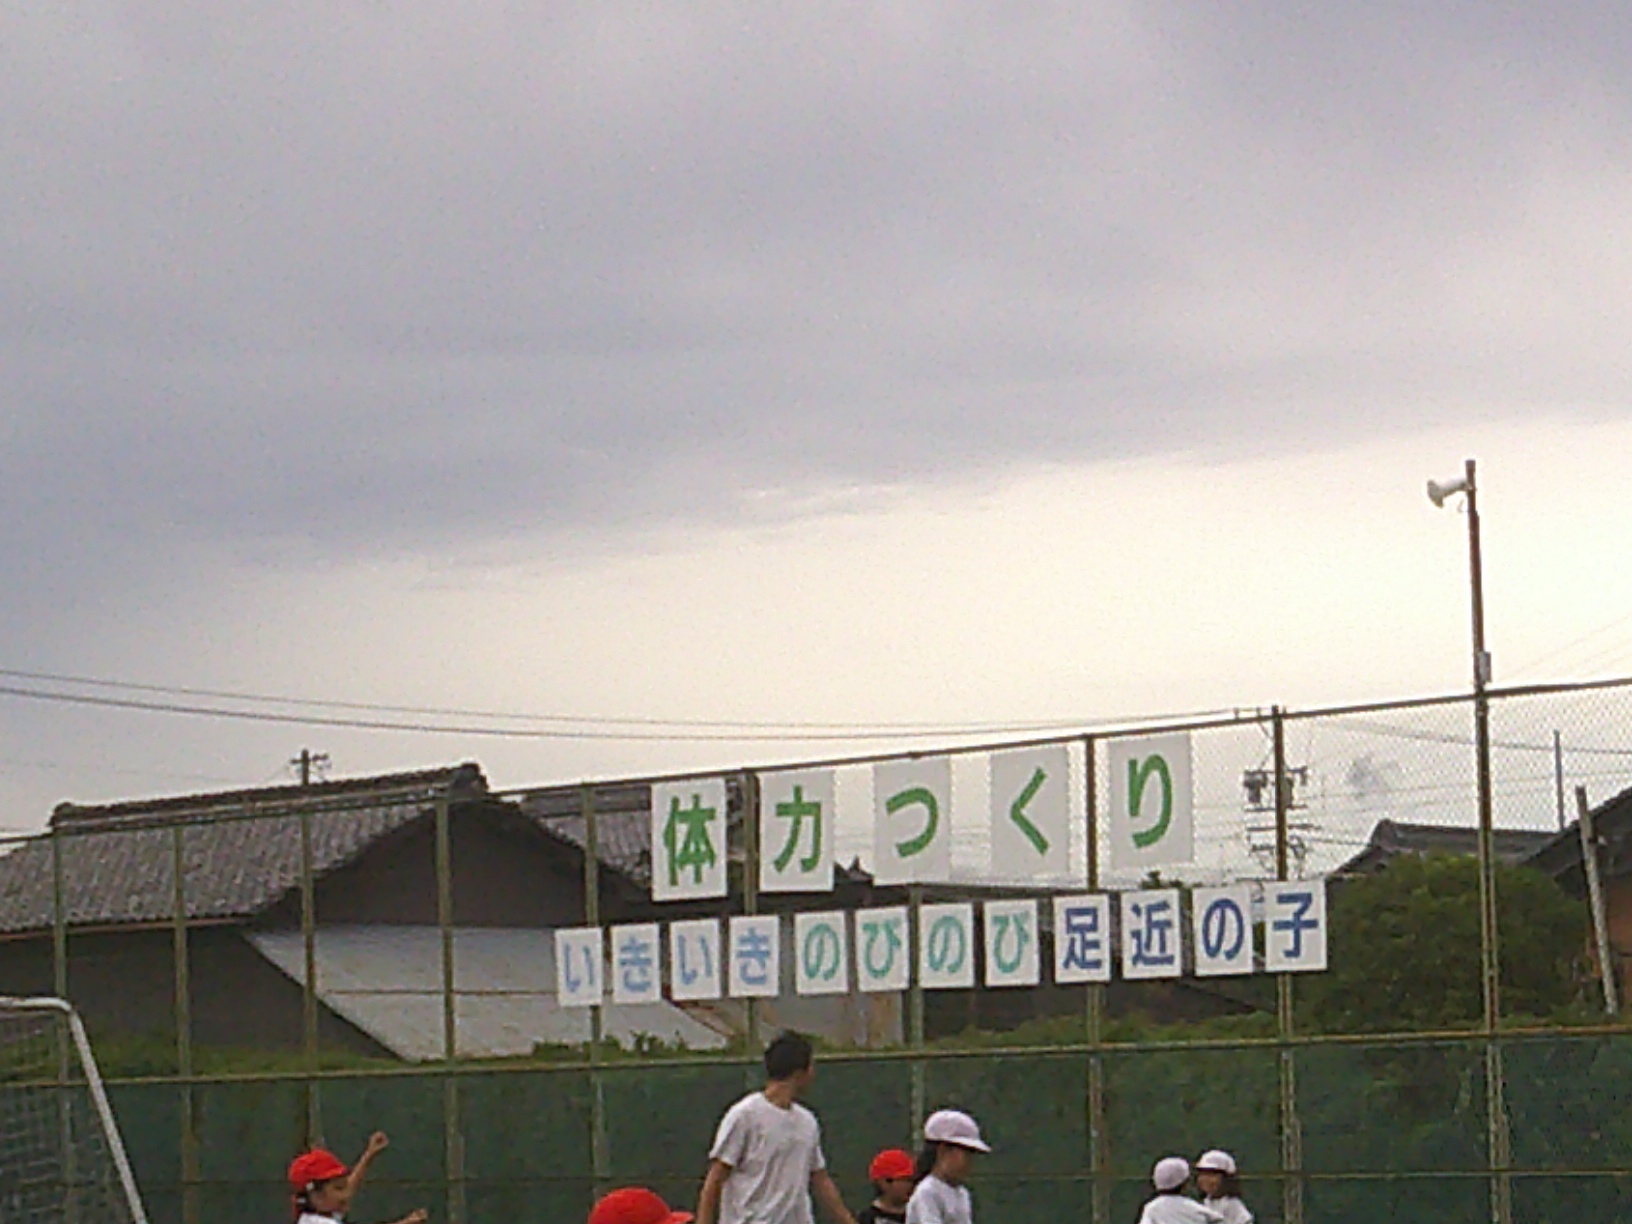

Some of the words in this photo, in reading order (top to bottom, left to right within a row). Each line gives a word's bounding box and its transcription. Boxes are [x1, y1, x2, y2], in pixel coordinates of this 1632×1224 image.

[663, 753, 1173, 886] 体力つくり
